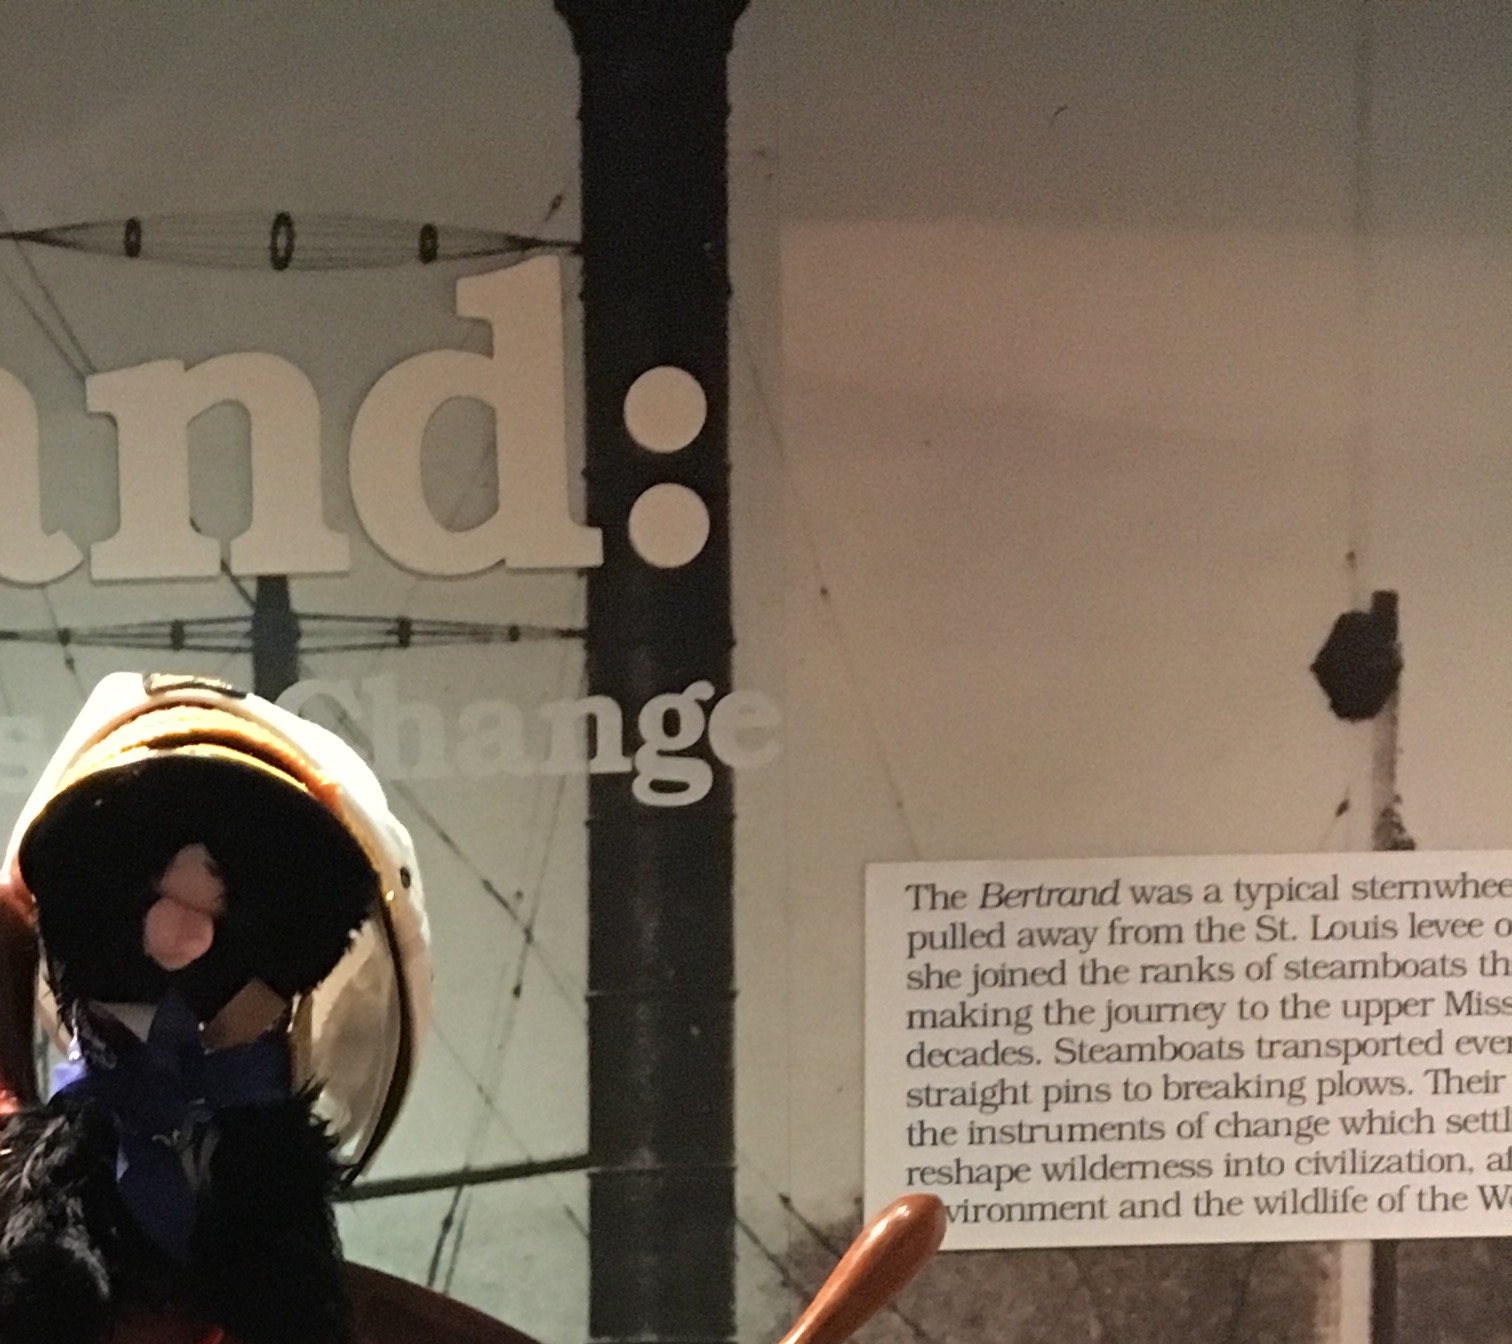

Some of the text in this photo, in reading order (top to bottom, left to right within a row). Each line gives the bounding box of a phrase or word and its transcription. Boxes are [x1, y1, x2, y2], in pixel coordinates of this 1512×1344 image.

[905, 882, 968, 911] The
[979, 878, 1121, 910] Bertrand
[1129, 883, 1193, 906] was
[1203, 883, 1223, 902] a
[1234, 874, 1339, 910] typical
[907, 921, 1006, 959] pulled
[1017, 926, 1098, 953] away
[1107, 917, 1184, 945] from
[1195, 916, 1246, 943] the
[1256, 914, 1298, 942] St.
[1310, 914, 1399, 941] Louis
[1408, 912, 1484, 939] levee
[906, 963, 962, 990] she
[967, 958, 1067, 997] joined
[1079, 958, 1130, 985] the
[1140, 955, 1235, 984] ranks
[1245, 953, 1278, 981] of
[1284, 951, 1467, 981] steamboats
[906, 1001, 1034, 1035] making
[1043, 998, 1096, 1026] the
[1100, 996, 1226, 1033] journey
[1238, 997, 1270, 1021] to
[1280, 992, 1331, 1019] the
[1342, 996, 1435, 1026] upper
[906, 1039, 1041, 1068] decades.
[1054, 1035, 1245, 1065] Steamboats
[1255, 1029, 1443, 1065] transported
[906, 1067, 1506, 1114] straight pins to breaking plows. Their
[906, 1119, 958, 1147] the
[967, 1116, 1165, 1146] instruments
[1176, 1111, 1209, 1140] of
[1215, 1111, 1330, 1144] change
[1338, 1107, 1435, 1136] which
[906, 1157, 1031, 1192] reshape
[1041, 1154, 1213, 1183] wilderness
[1223, 1152, 1285, 1177] into
[1295, 1148, 1474, 1176] civilization,
[945, 1195, 1110, 1224] vironment
[1119, 1190, 1182, 1219] and
[1194, 1190, 1244, 1217] the
[1253, 1185, 1368, 1215] wildlife
[1377, 1184, 1410, 1213] of
[1417, 1185, 1469, 1212] the
